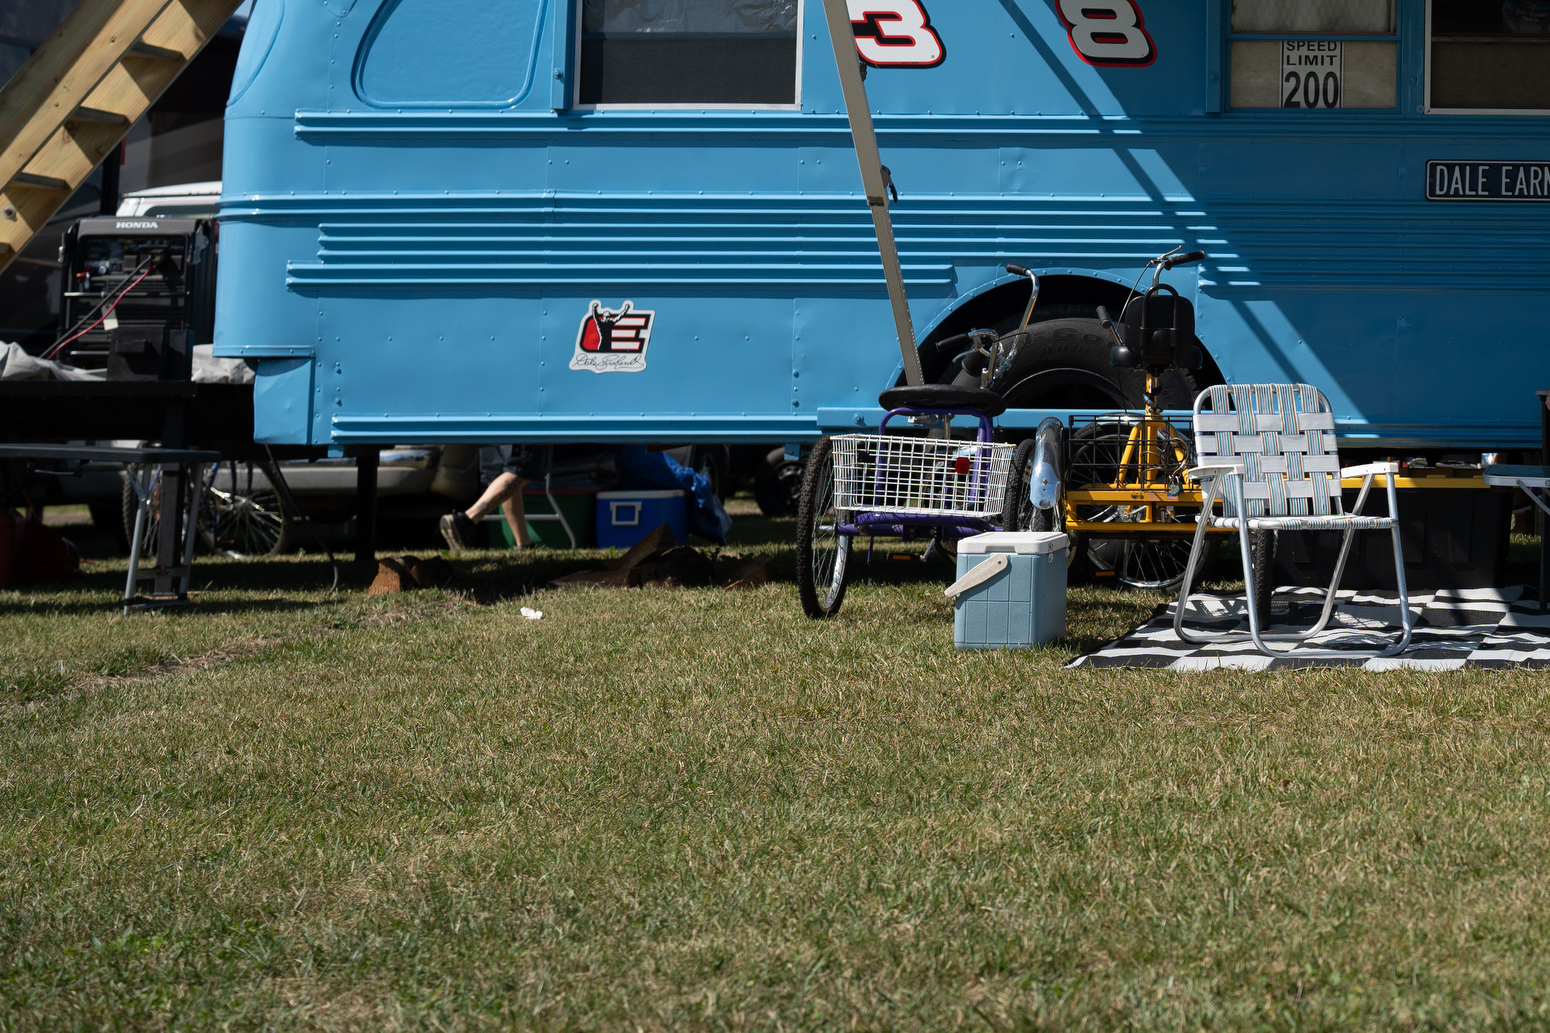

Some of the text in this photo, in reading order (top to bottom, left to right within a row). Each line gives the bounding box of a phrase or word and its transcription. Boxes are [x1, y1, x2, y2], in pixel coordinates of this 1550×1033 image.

[1286, 40, 1338, 52] SPEED
[1286, 54, 1338, 66] LIMIT
[1283, 70, 1339, 109] 200
[1435, 165, 1490, 196] DALE
[116, 221, 159, 229] HONDA
